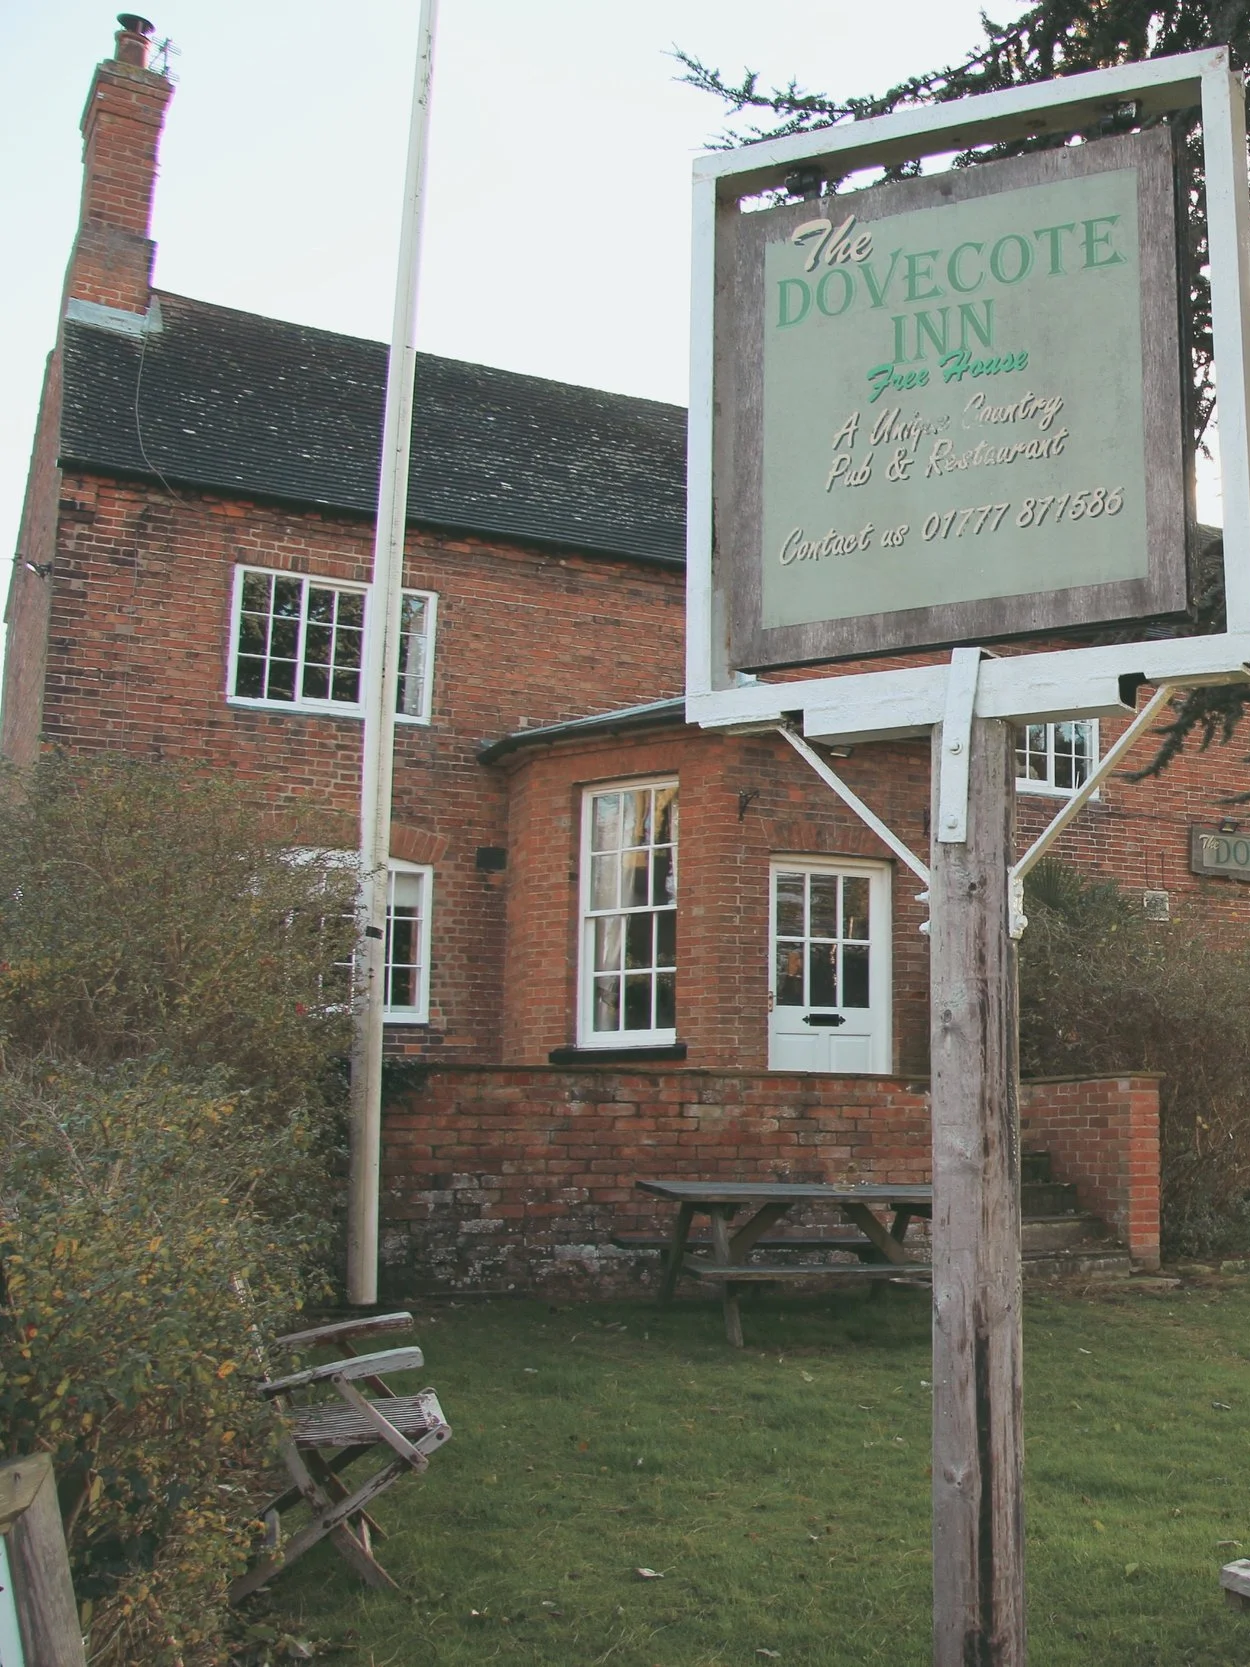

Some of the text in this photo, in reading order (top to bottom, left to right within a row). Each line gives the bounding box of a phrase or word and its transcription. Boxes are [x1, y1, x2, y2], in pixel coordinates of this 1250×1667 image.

[775, 214, 1128, 330] DOVECOTE
[791, 213, 874, 272] The
[891, 300, 995, 366] INN
[866, 349, 1029, 402] Free House
[825, 427, 1070, 492] Pub & Restaurant
[832, 412, 860, 451] A
[779, 486, 1125, 566] Contact us 01777 871586
[1199, 834, 1220, 850] The
